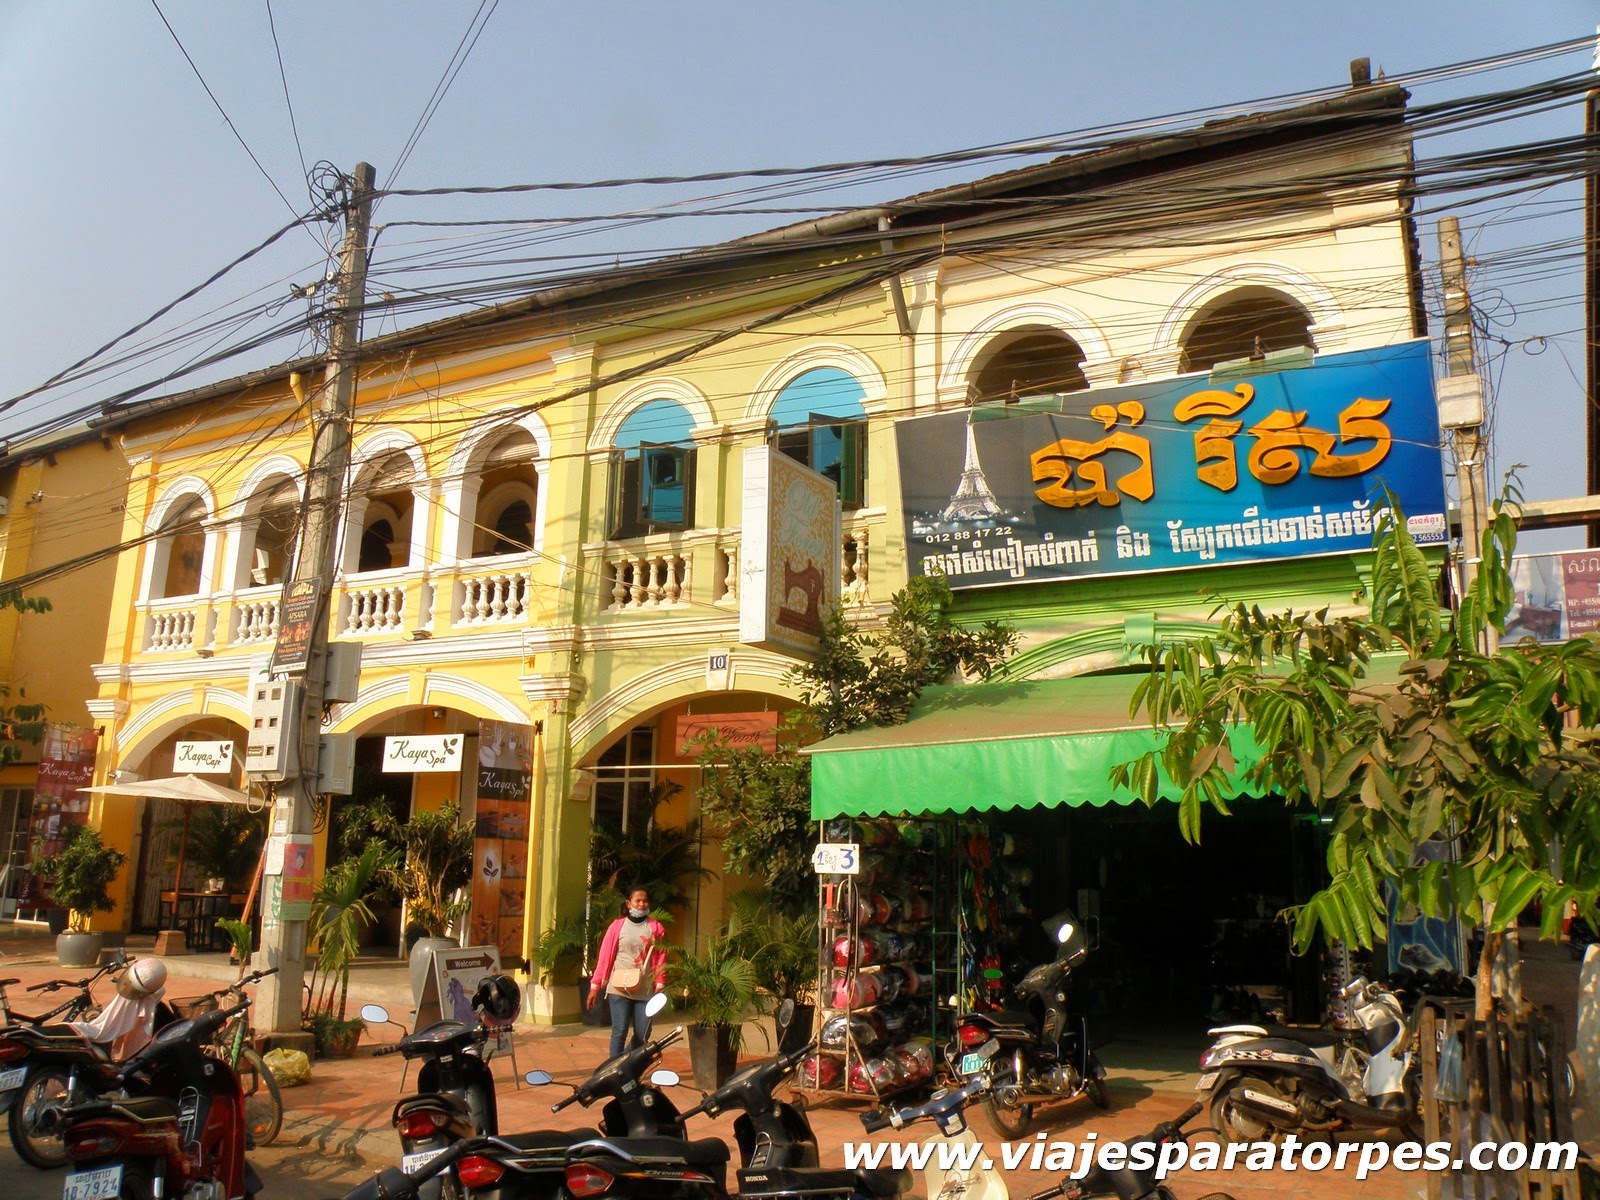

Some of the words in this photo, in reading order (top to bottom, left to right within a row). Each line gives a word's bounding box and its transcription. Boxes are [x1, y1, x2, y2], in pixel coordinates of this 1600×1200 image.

[926, 533, 951, 543] 012
[954, 531, 970, 540] 88
[974, 528, 991, 538] 17
[995, 526, 1012, 536] 22
[1418, 532, 1444, 542] 565553
[712, 656, 725, 669] 10
[179, 744, 207, 766] Kaya
[389, 740, 429, 764] Kaya
[426, 749, 447, 768] Spa
[38, 762, 69, 779] Kaya
[478, 771, 512, 794] Kaya
[509, 783, 525, 798] Spa
[454, 960, 482, 968] Welcome
